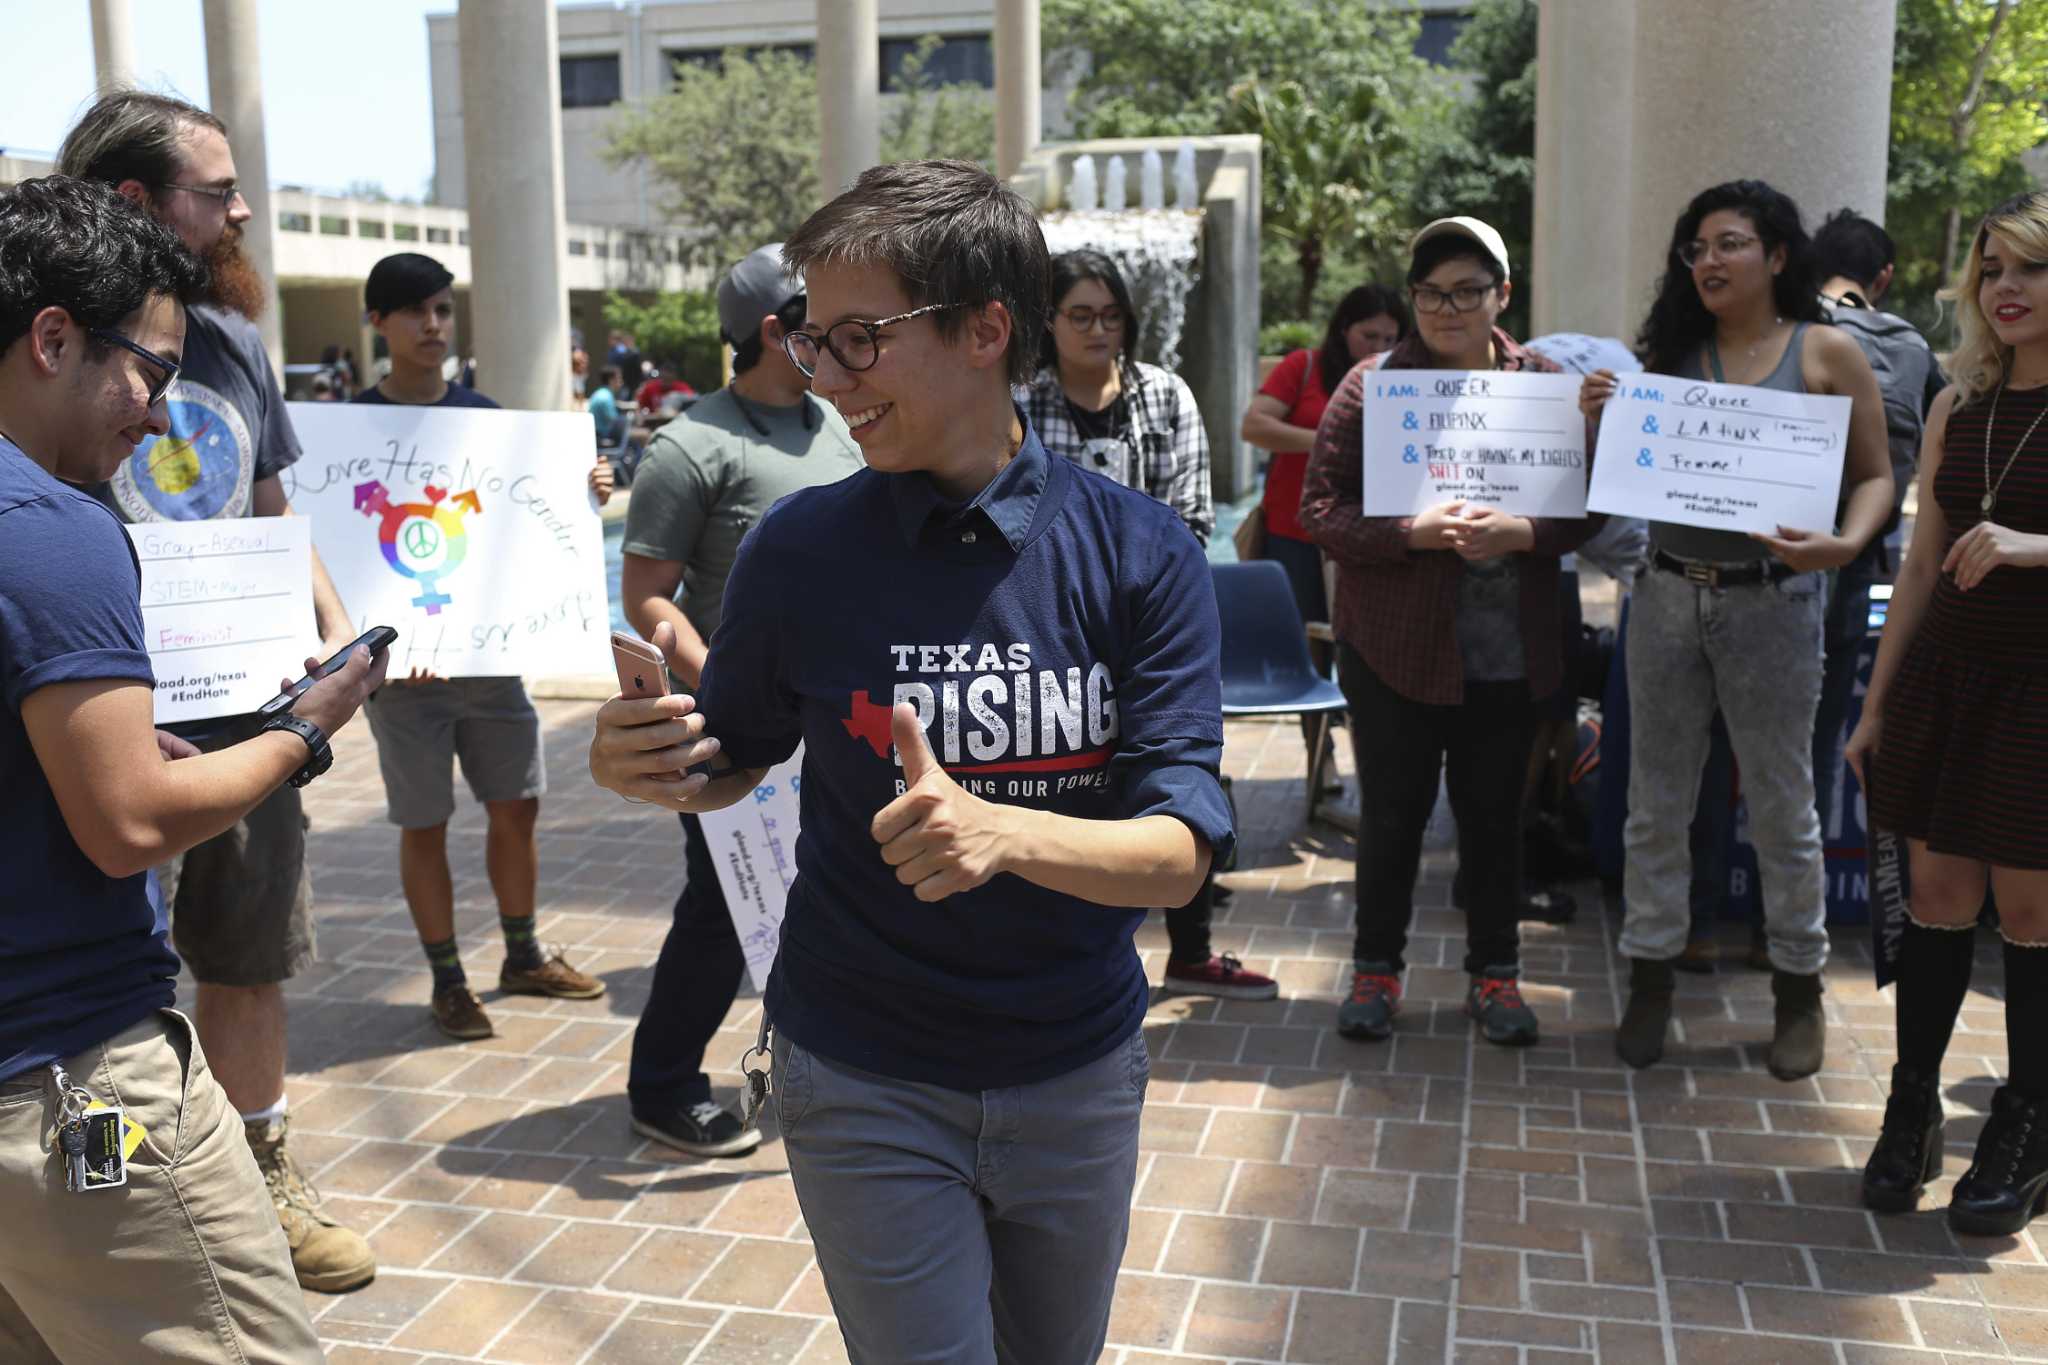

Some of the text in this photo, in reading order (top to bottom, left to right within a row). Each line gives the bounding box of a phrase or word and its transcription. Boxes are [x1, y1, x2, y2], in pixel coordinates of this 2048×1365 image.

[1388, 384, 1419, 398] AM:
[1434, 377, 1491, 397] QUEER
[1632, 387, 1664, 402] AM:
[1402, 411, 1419, 430] &
[1642, 414, 1659, 433] &
[1402, 443, 1419, 463] &
[1478, 449, 1517, 464] HAVING
[1521, 449, 1536, 467] MY
[1540, 449, 1583, 469] RIGHTS
[1636, 448, 1653, 467] &
[283, 457, 374, 500] Love
[377, 439, 453, 486] Has
[459, 457, 504, 493] No
[1427, 462, 1486, 481] SHIT ON
[891, 643, 1031, 673] TEXAS
[155, 671, 248, 690] laad.org/texas
[171, 688, 230, 703] #EndHate
[893, 662, 1119, 767] RISING
[754, 785, 776, 804] &
[1008, 780, 1048, 797] OUR
